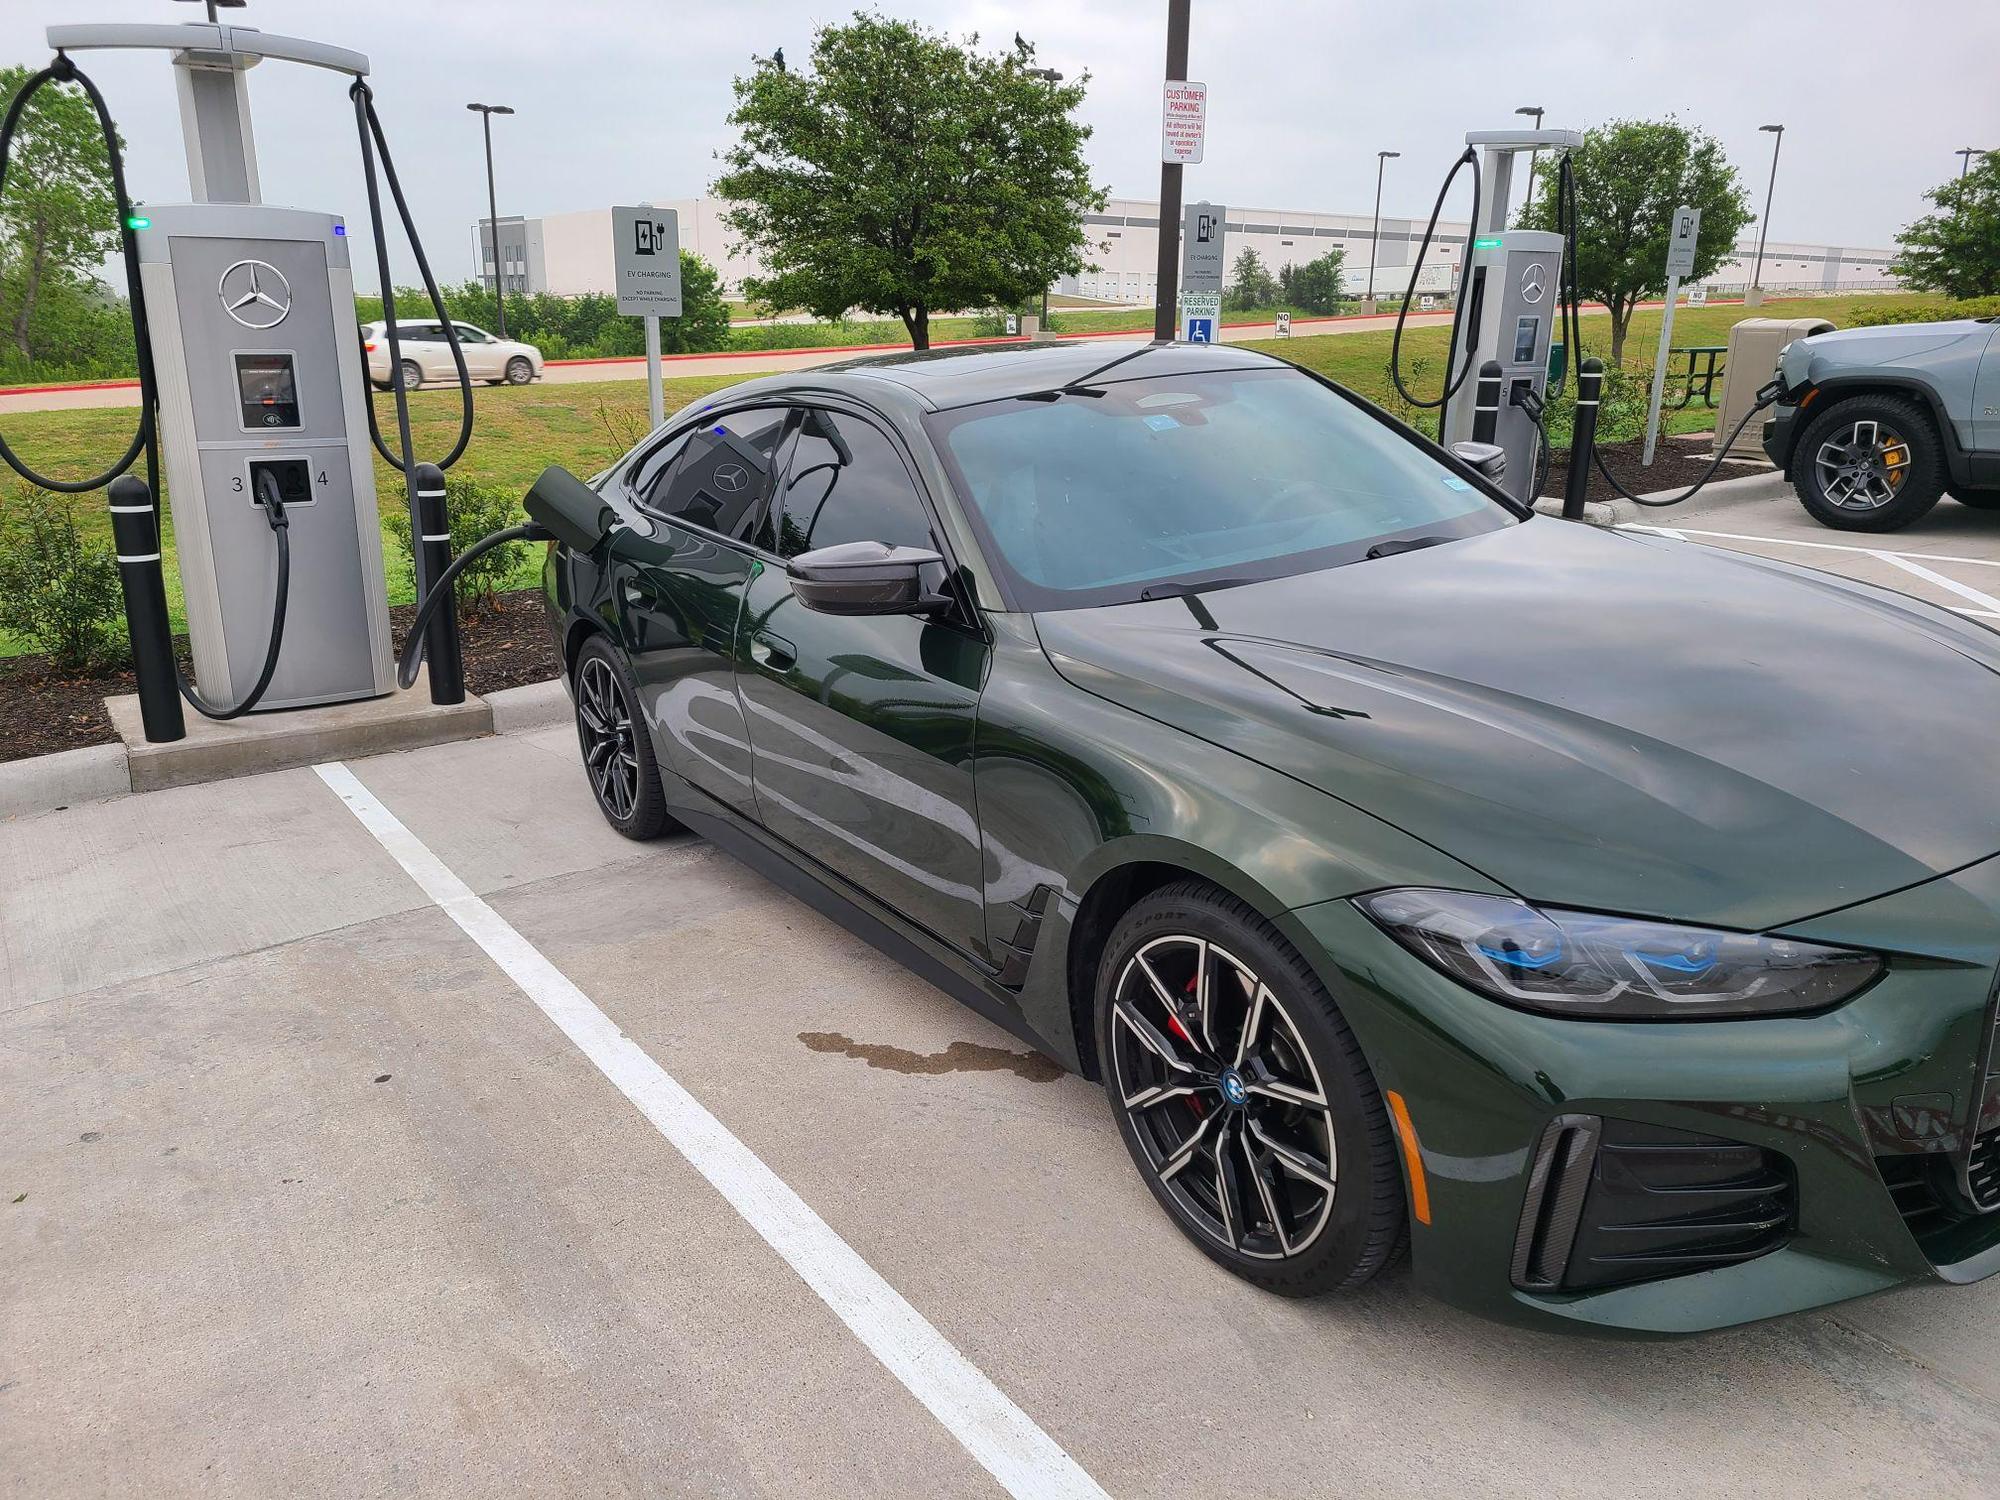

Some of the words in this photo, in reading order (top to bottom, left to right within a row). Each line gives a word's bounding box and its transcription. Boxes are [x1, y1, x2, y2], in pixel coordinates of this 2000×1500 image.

[1166, 89, 1204, 101] CUSTOMER
[1170, 101, 1200, 112] PARKING
[627, 270, 635, 278] EV
[637, 270, 672, 279] CHARGING
[1184, 297, 1219, 306] RESERVED
[1187, 307, 1216, 316] PARKING
[1277, 313, 1289, 321] NO
[1502, 388, 1507, 397] 5
[232, 477, 243, 492] 3
[317, 471, 329, 486] 4
